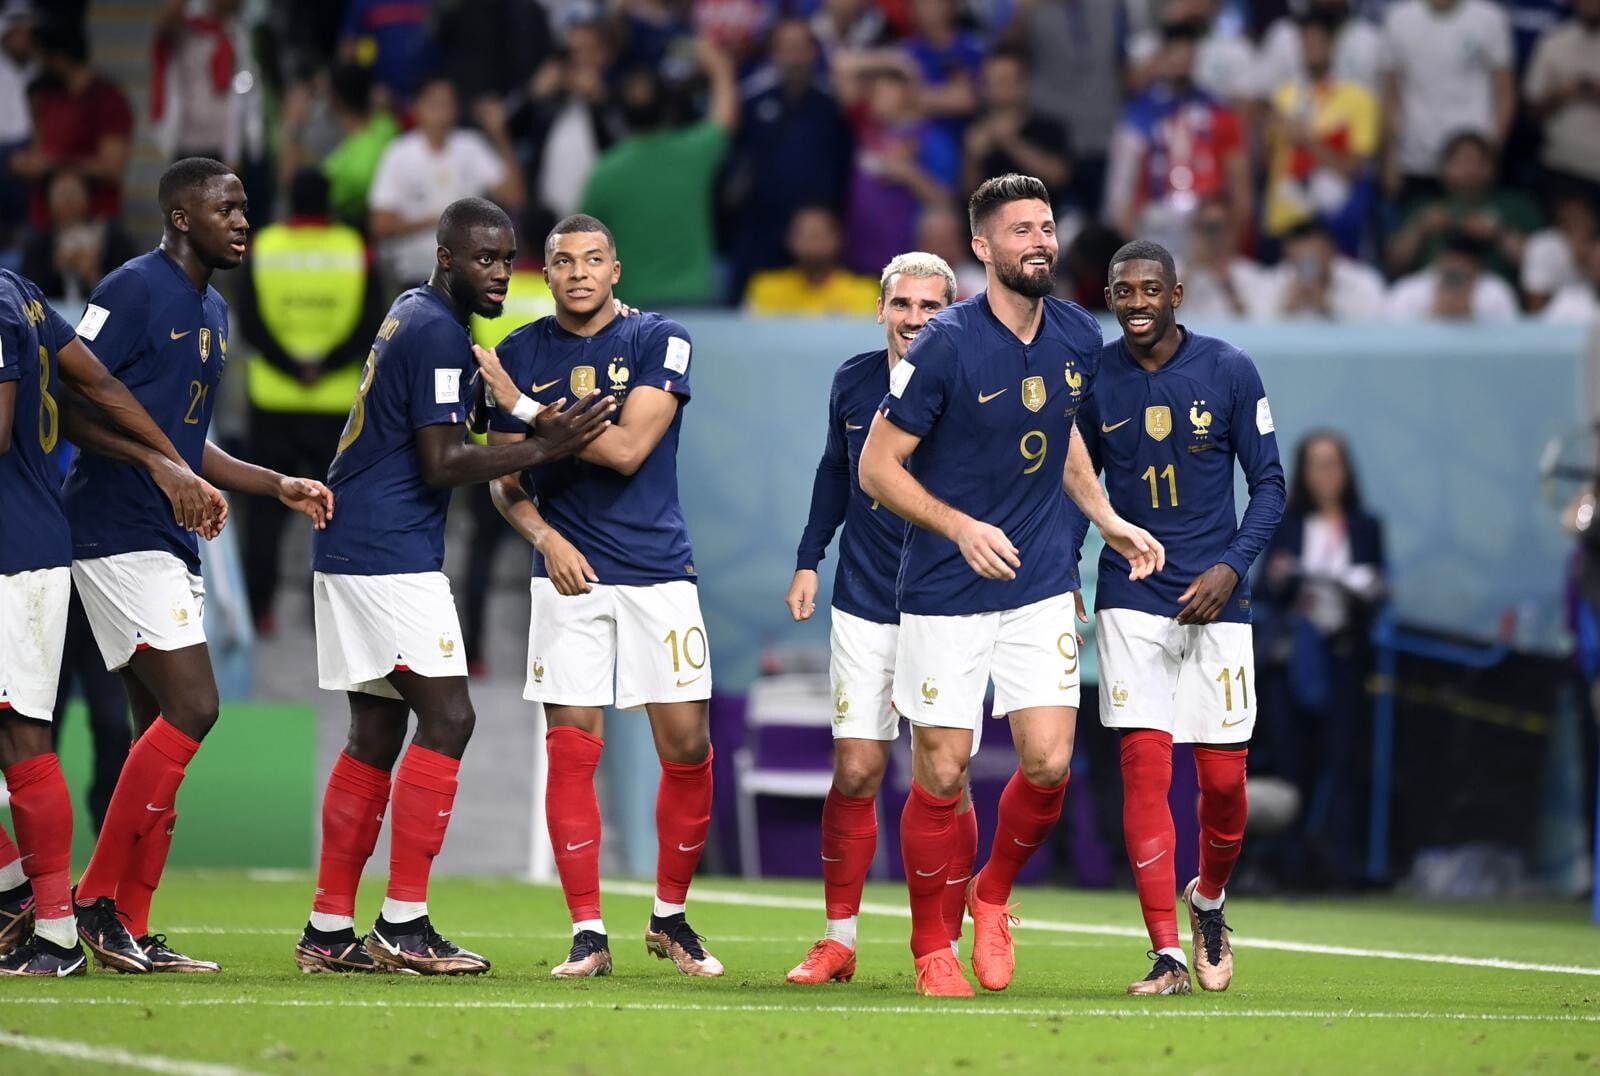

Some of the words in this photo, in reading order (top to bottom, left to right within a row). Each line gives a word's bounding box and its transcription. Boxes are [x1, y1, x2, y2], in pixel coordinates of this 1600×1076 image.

[39, 344, 58, 454] 8
[1020, 430, 1048, 475] 9
[1140, 463, 1179, 509] 11
[663, 626, 707, 673] 10
[1056, 632, 1078, 675] 9
[1215, 665, 1248, 712] 11
